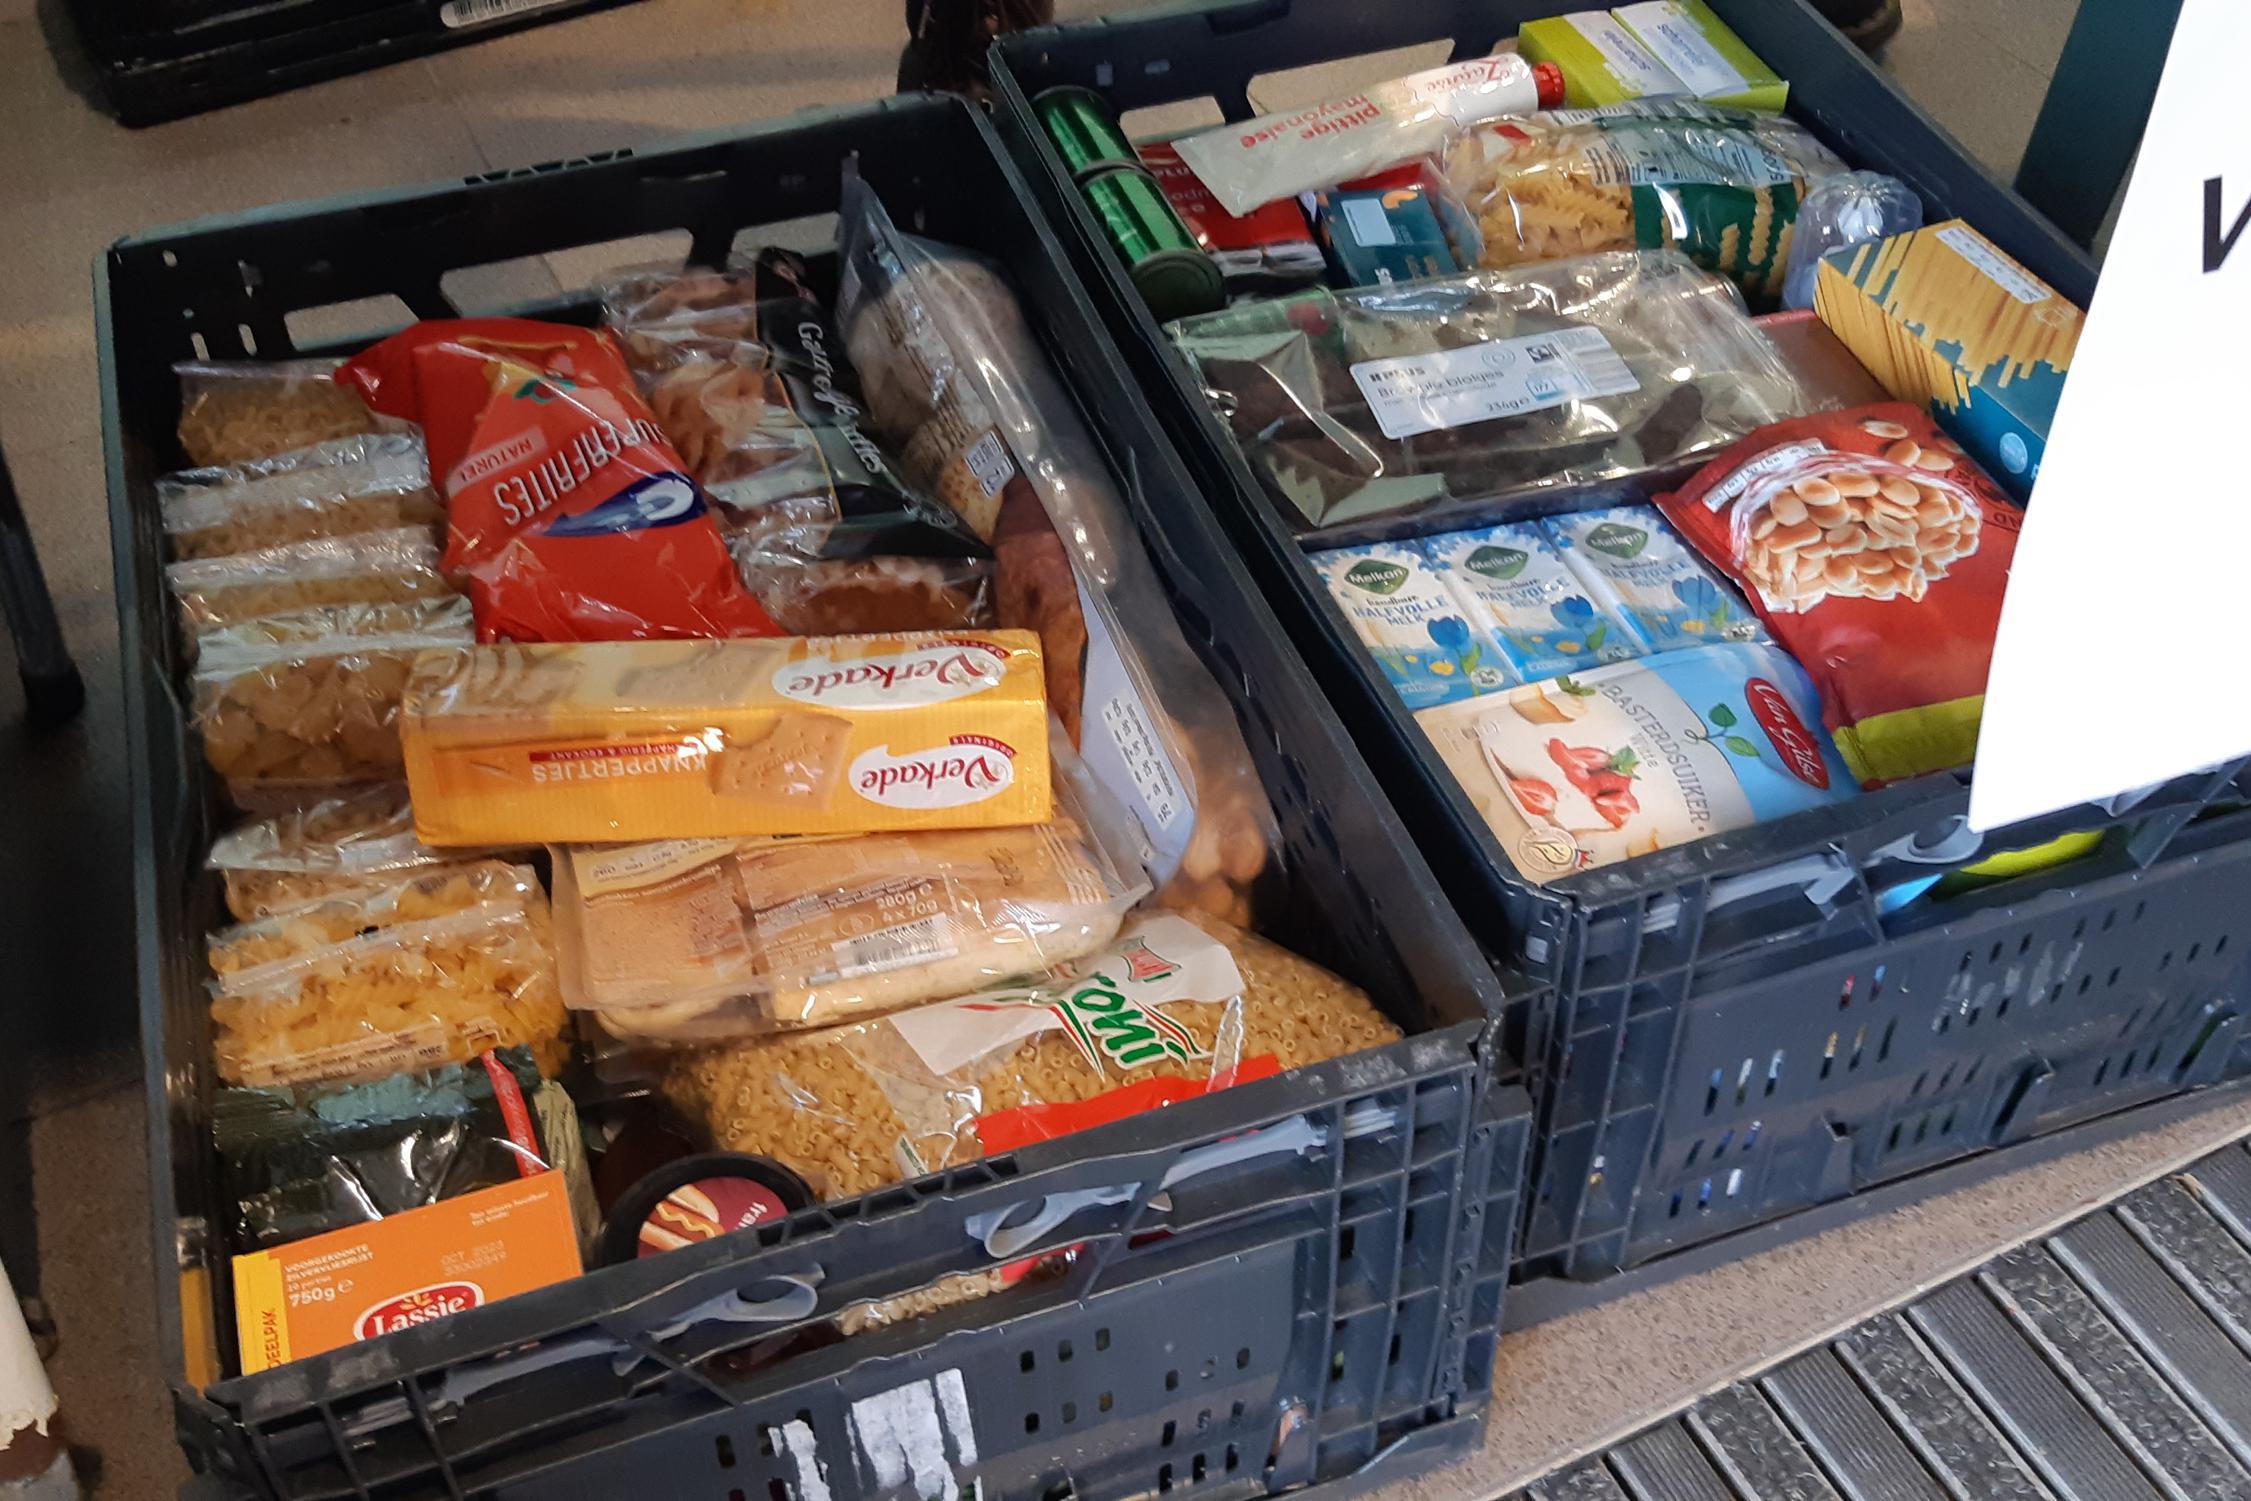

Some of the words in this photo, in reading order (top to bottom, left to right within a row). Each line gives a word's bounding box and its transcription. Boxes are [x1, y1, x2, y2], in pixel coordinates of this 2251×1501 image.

[1240, 93, 1369, 149] mayonaise
[1300, 101, 1382, 139] pittige
[1348, 566, 1407, 587] Melkan
[1469, 551, 1527, 571] Melkan
[1353, 595, 1446, 621] HALFVOLLE
[1386, 612, 1425, 628] MELK
[789, 651, 985, 697] Verkade
[1751, 682, 1785, 732] Van
[1778, 728, 1821, 784] Gilse
[532, 754, 707, 783] KNAPPERTJES
[860, 754, 999, 795] Verkade
[1602, 684, 1711, 827] BASTERDSUIKER
[288, 1287, 336, 1308] 750g
[372, 1294, 466, 1336] Lassie
